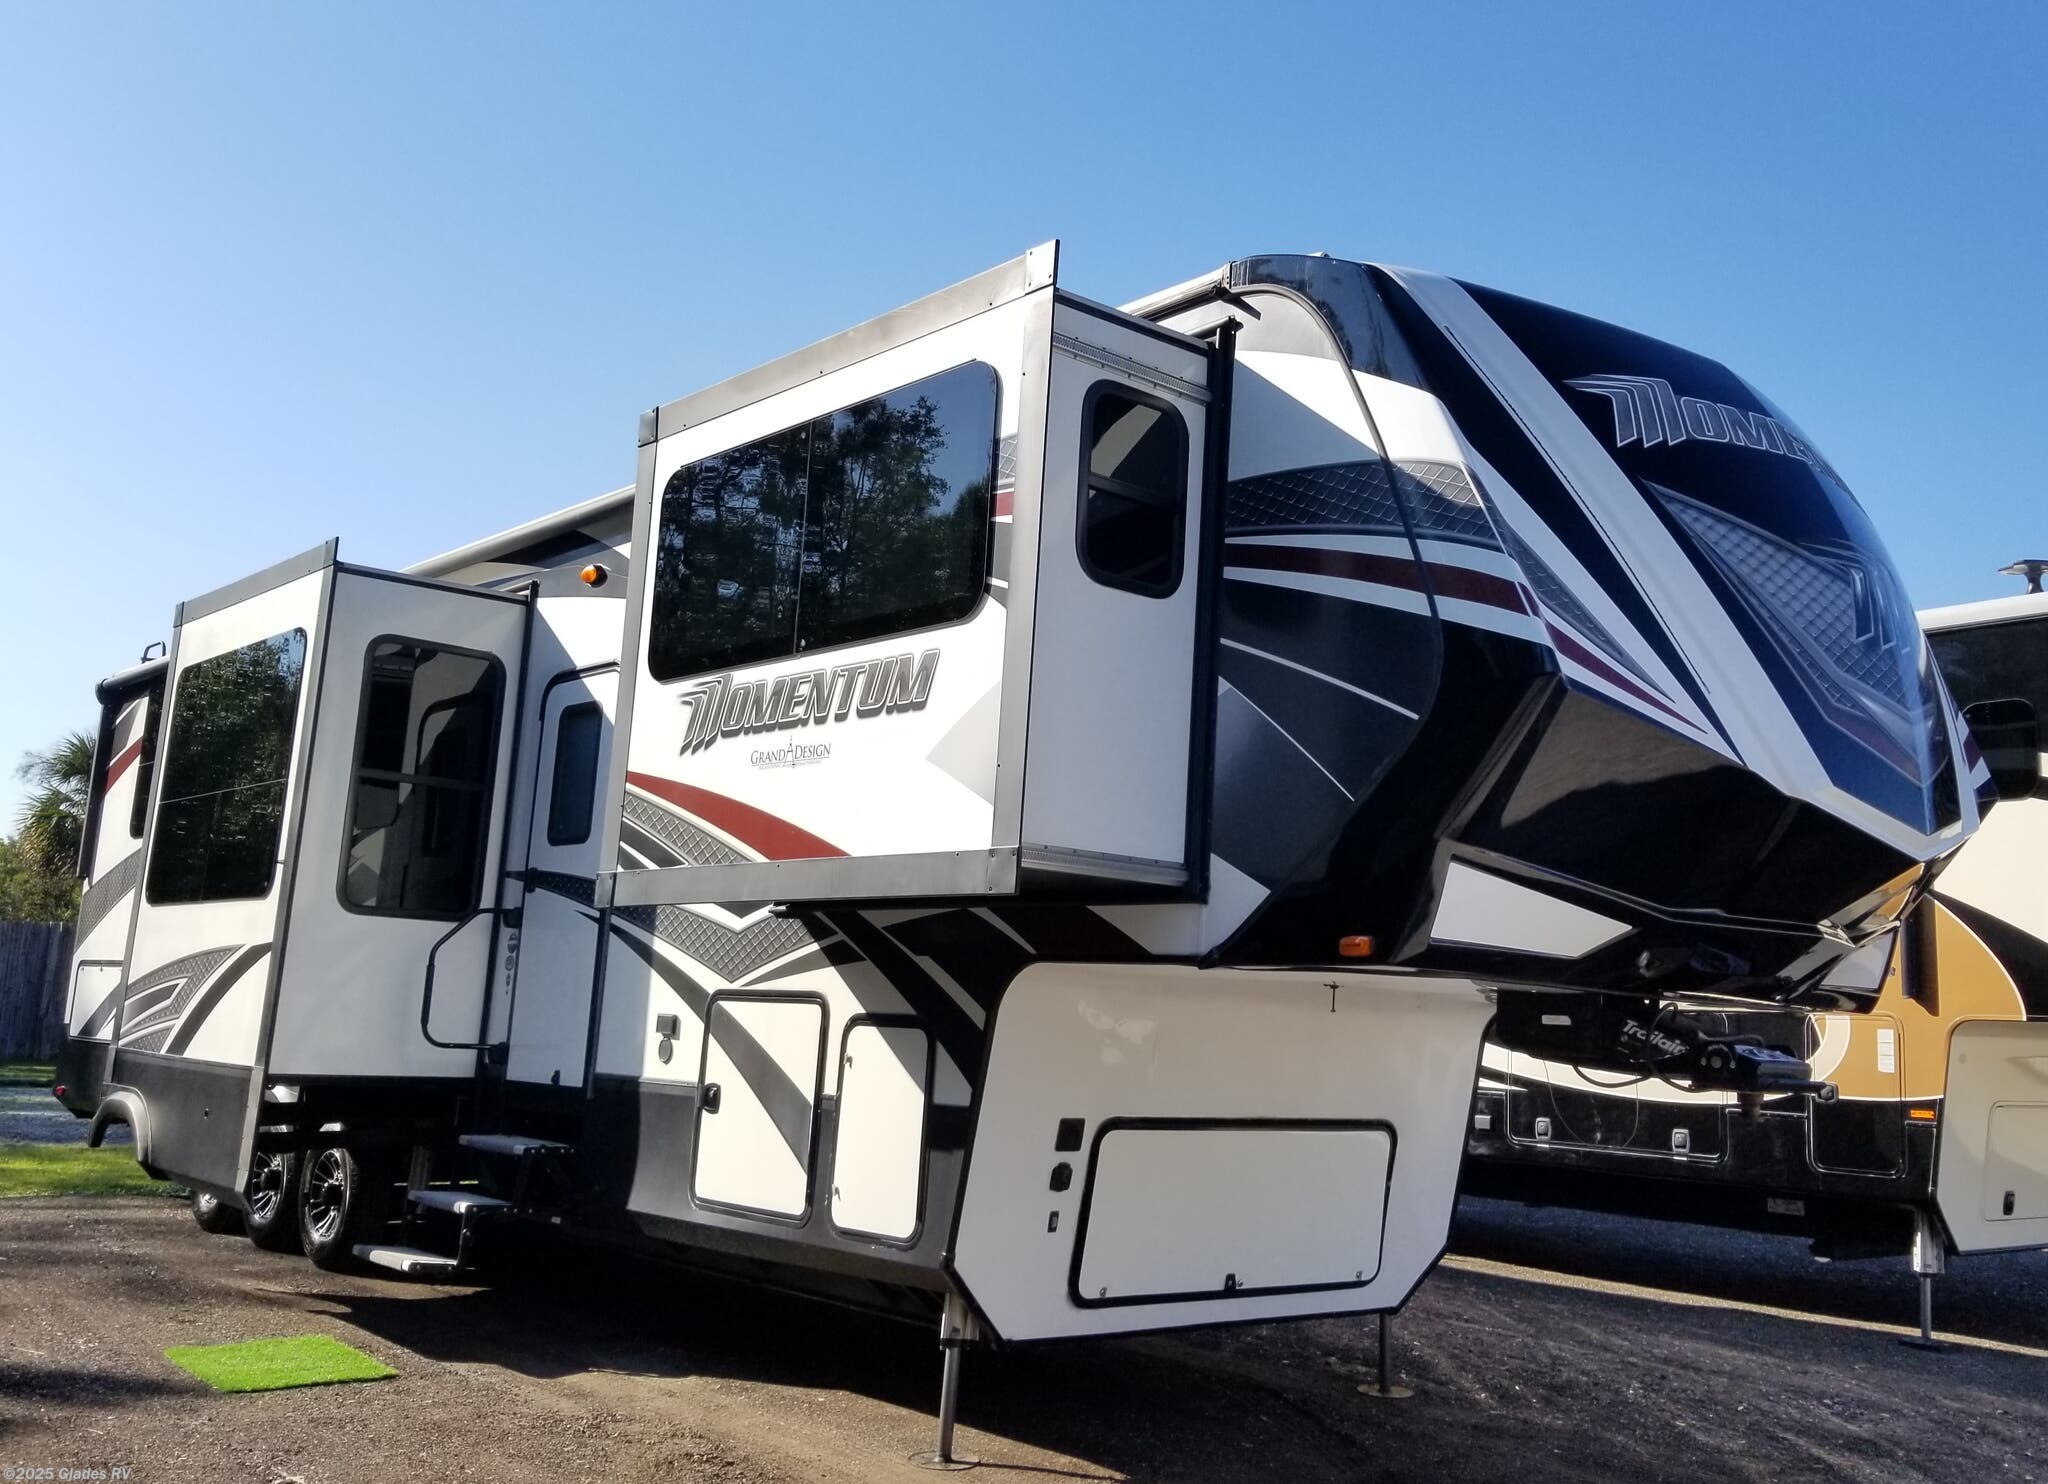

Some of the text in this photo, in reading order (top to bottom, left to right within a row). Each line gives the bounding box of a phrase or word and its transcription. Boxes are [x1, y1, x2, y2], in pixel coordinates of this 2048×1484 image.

[679, 648, 941, 756] MOMENTUM
[751, 749, 786, 765] GRAND
[794, 743, 832, 760] DESIGN
